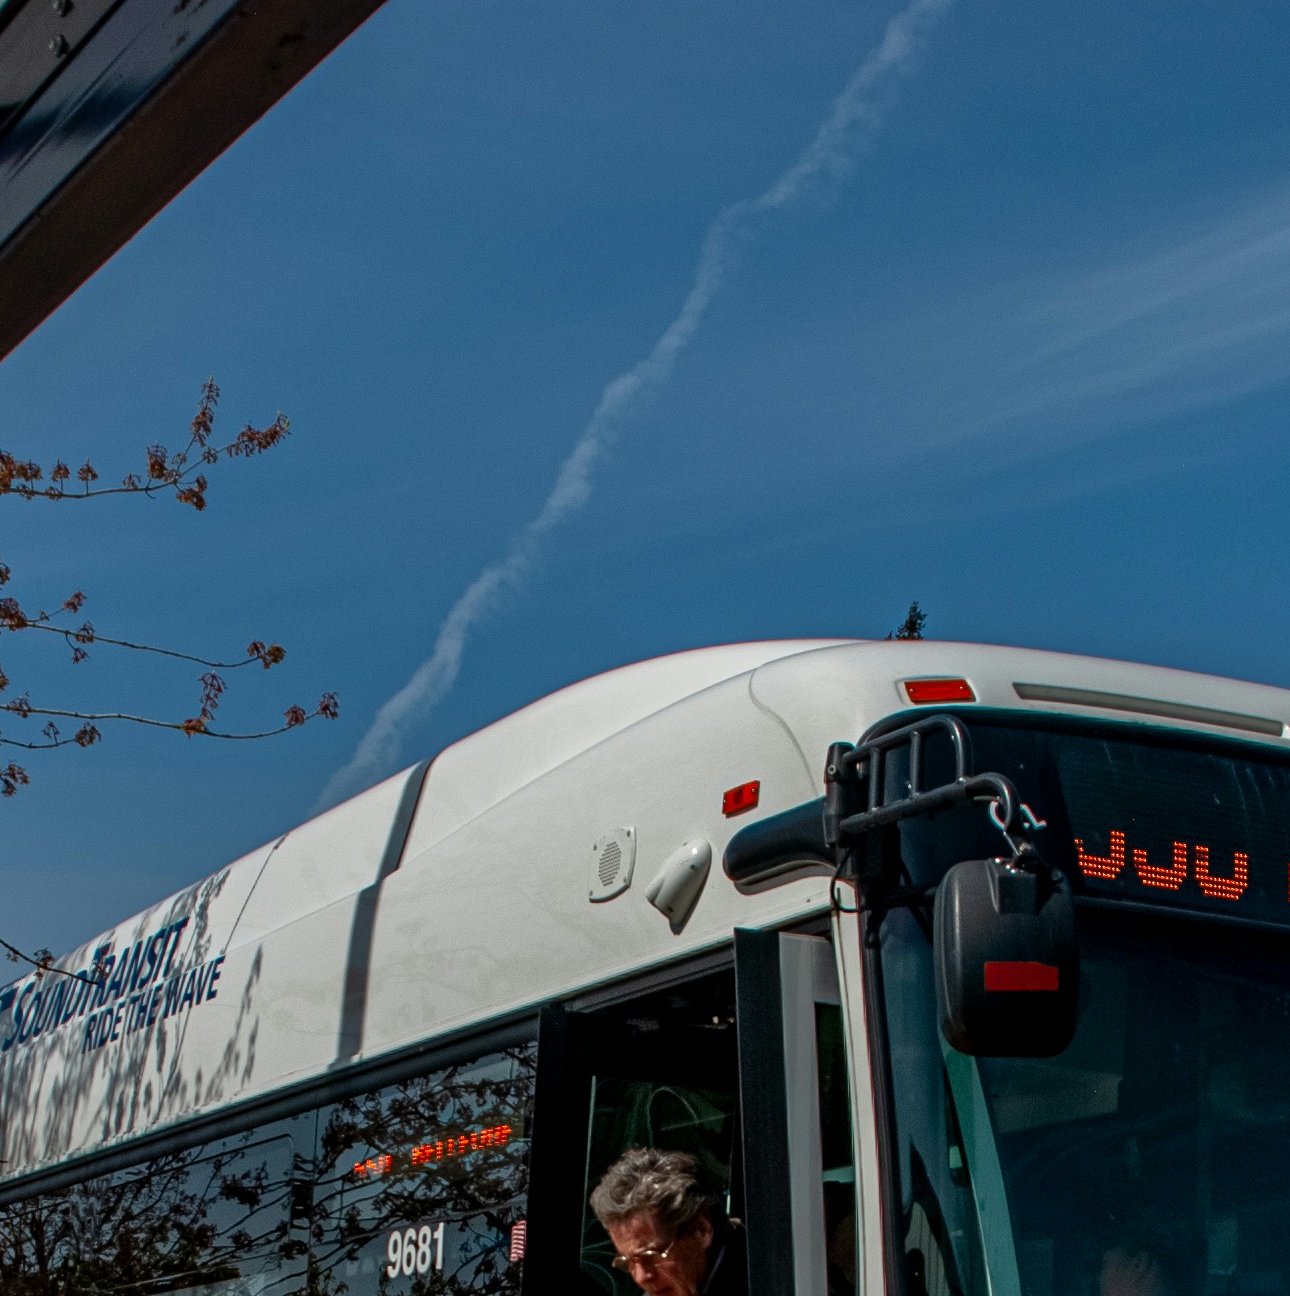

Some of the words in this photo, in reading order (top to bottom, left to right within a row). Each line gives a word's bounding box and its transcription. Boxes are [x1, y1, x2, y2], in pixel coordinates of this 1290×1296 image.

[83, 1001, 126, 1054] RIDE
[124, 984, 164, 1037] THE
[162, 955, 226, 1020] WAVE
[387, 1222, 445, 1278] 9681
